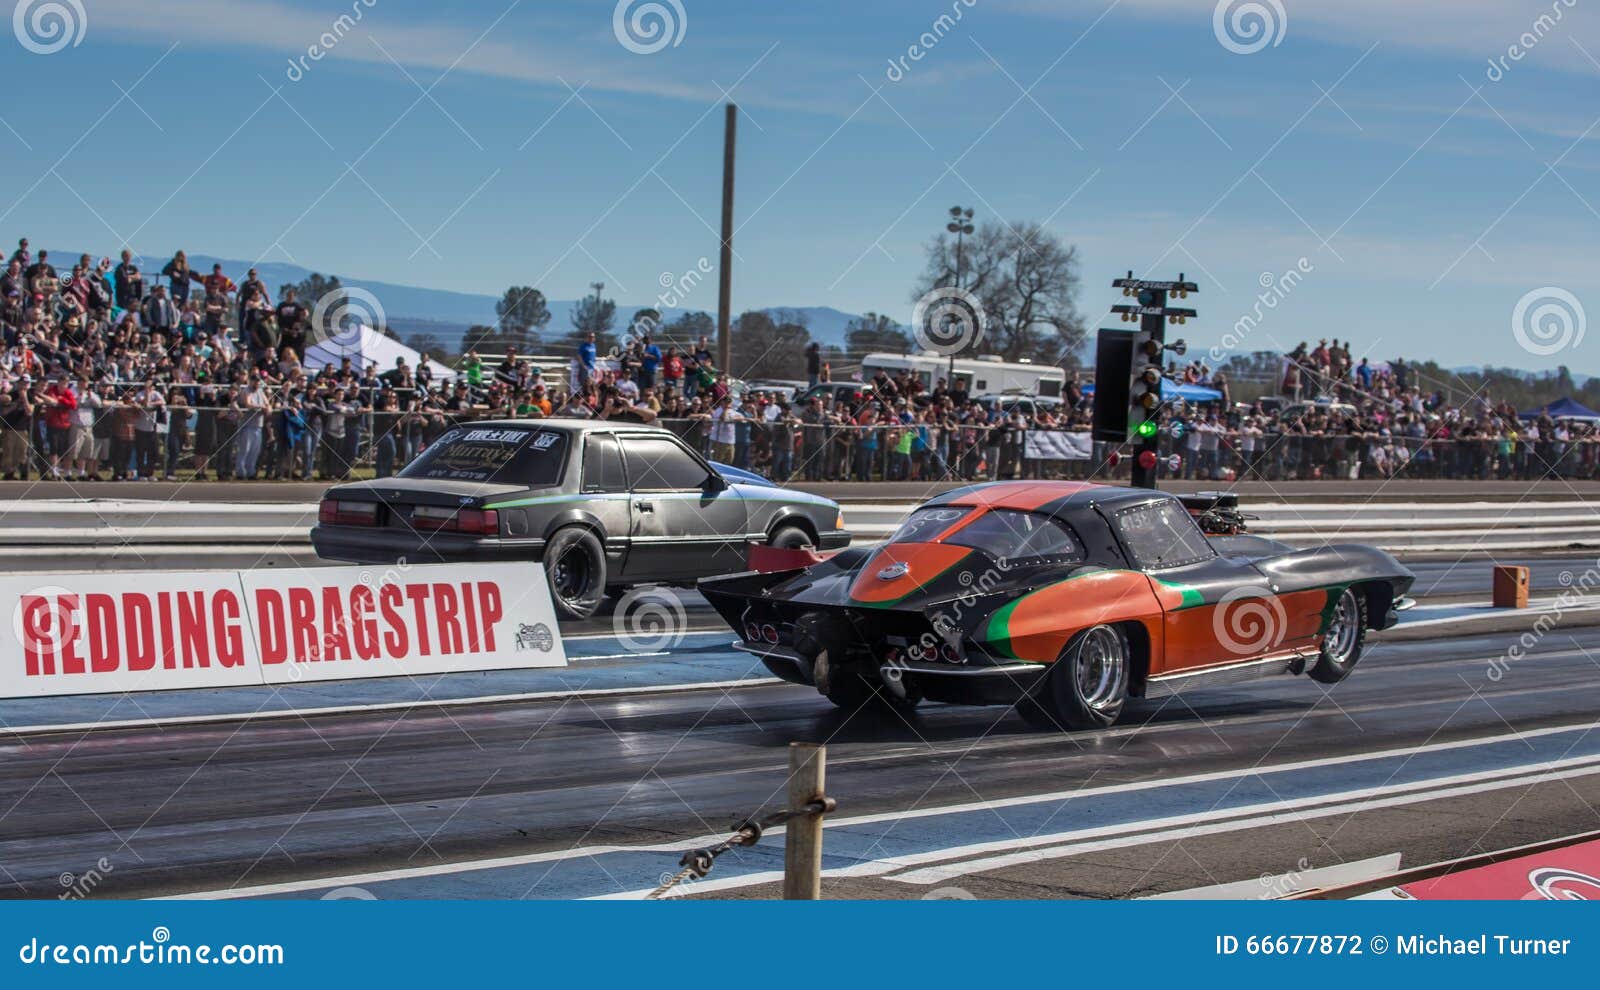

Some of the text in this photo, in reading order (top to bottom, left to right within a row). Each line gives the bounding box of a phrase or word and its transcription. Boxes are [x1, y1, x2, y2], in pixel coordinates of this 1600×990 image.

[1129, 305, 1163, 314] STAGE
[21, 581, 503, 676] REDDING DRAGSTRIP
